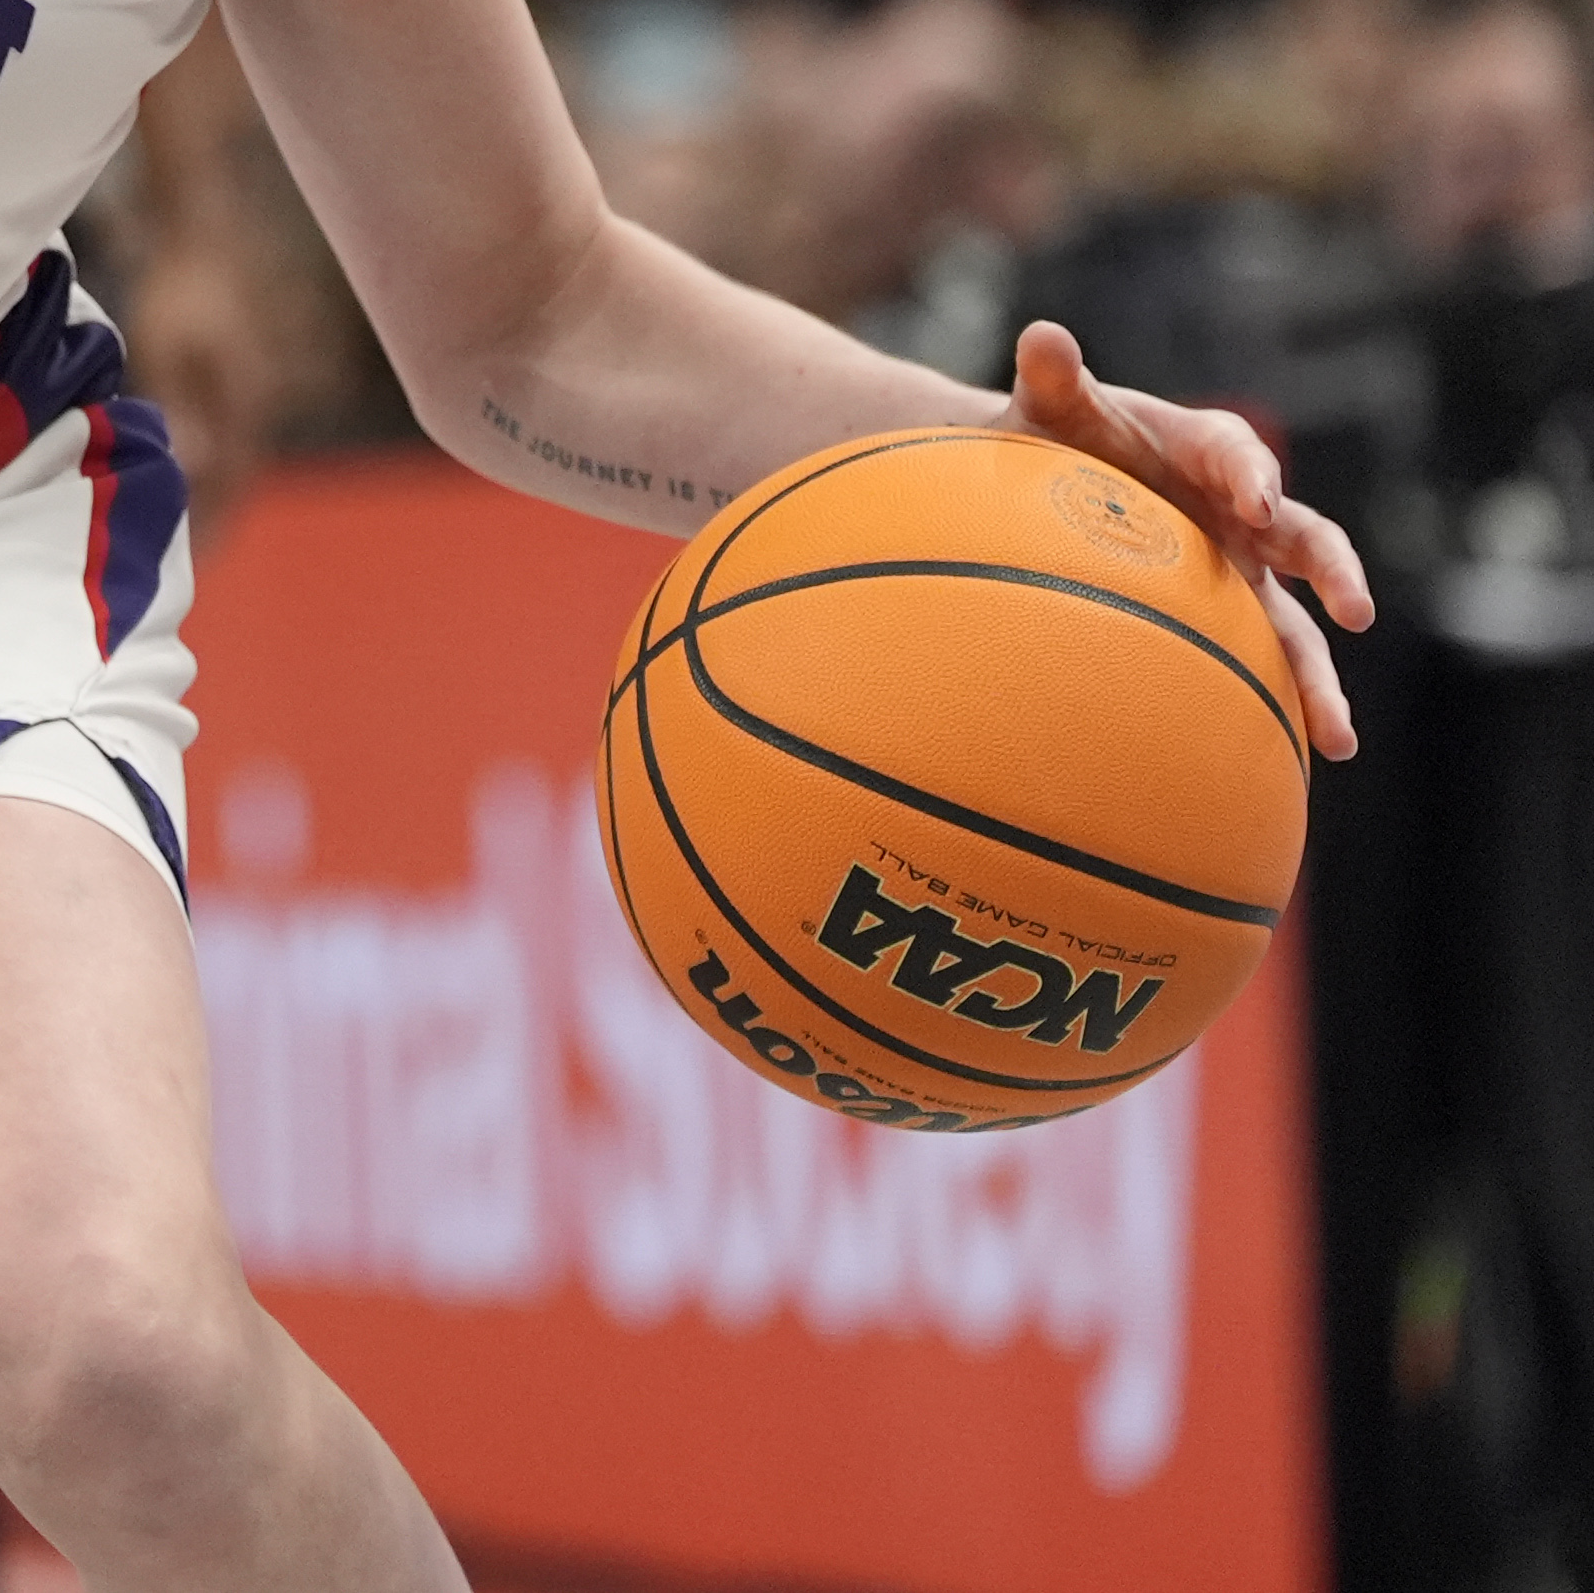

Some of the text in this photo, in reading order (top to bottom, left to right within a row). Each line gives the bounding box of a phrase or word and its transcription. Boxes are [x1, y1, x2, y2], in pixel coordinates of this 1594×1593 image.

[527, 436, 654, 492] JOURNEY
[667, 476, 696, 503] IS
[815, 859, 1166, 1055] NCAA
[869, 840, 1179, 968] OFFICIAL GAME BALL
[686, 948, 1105, 1135] son
